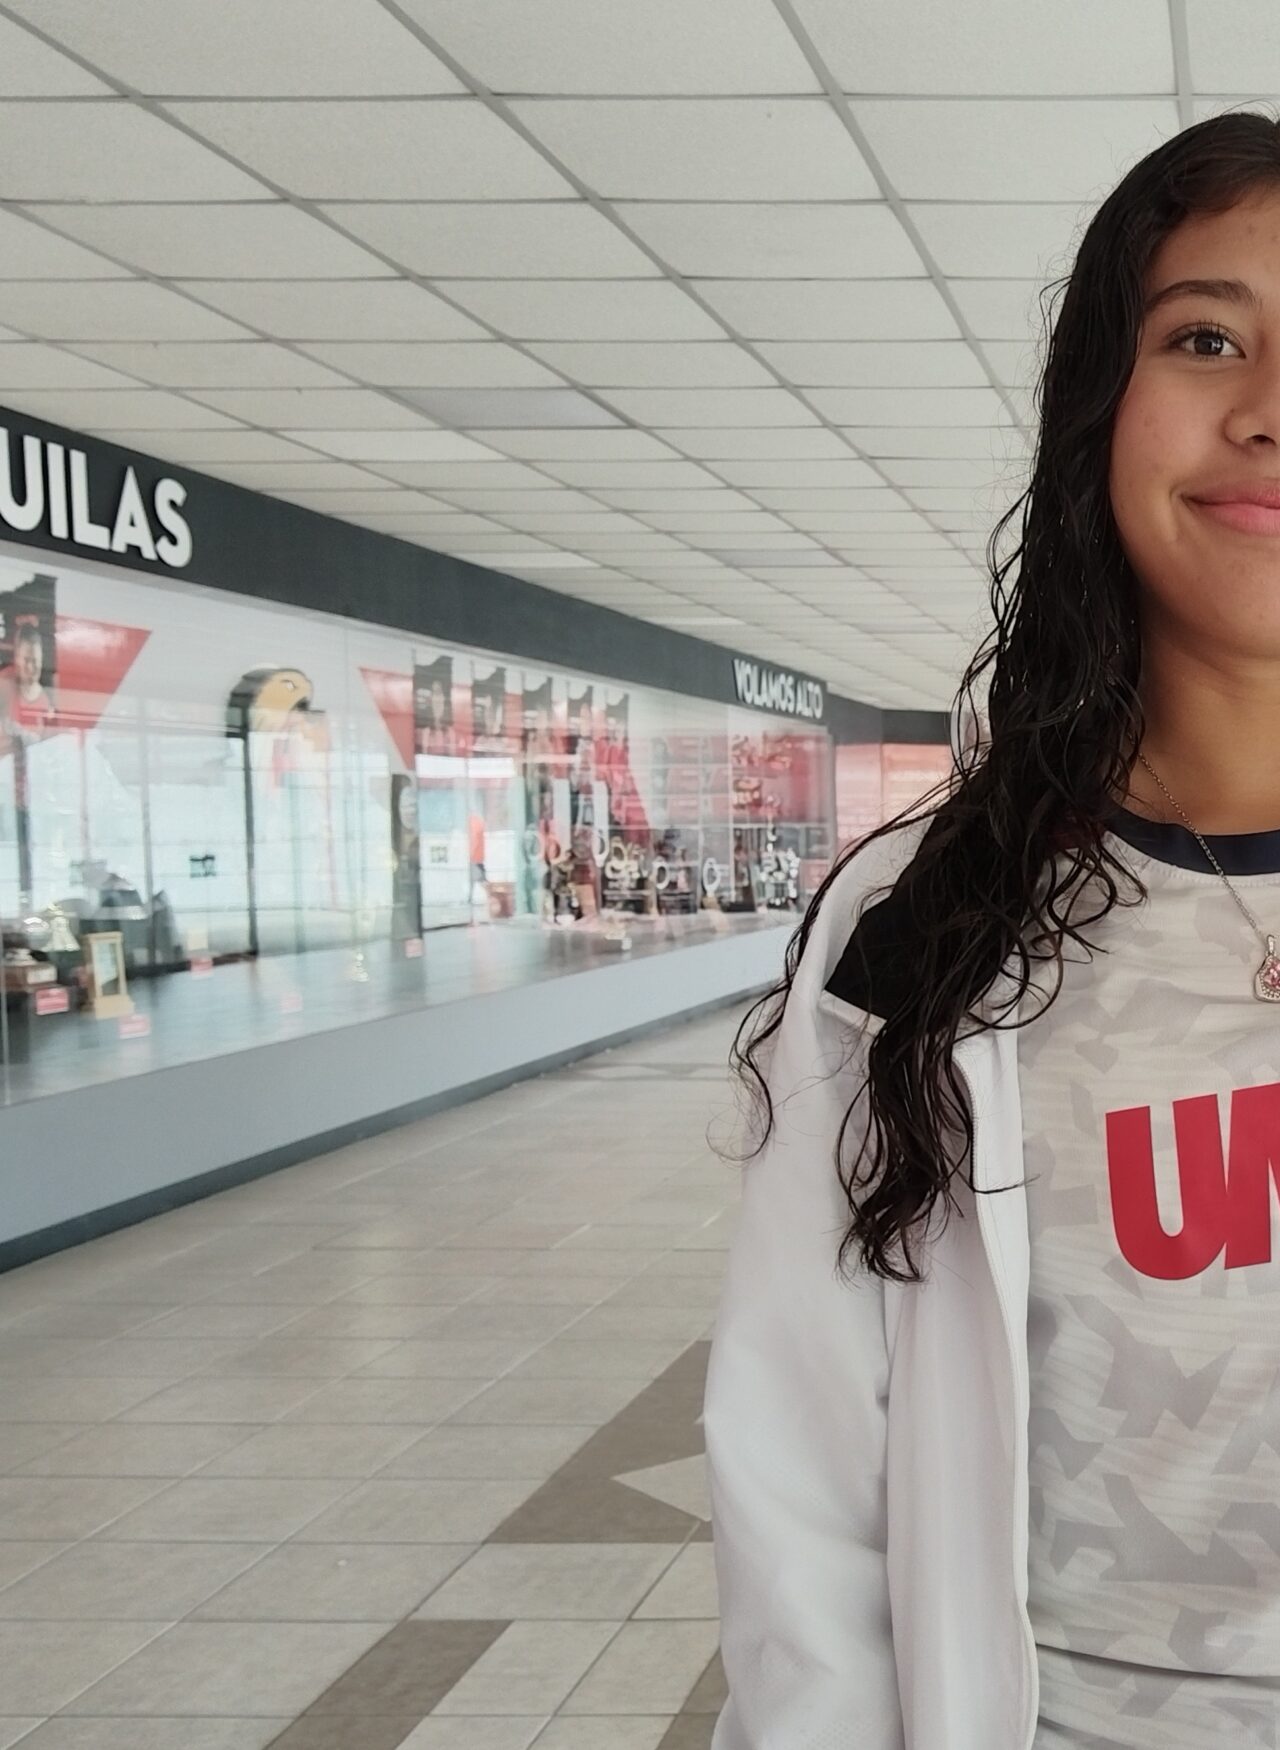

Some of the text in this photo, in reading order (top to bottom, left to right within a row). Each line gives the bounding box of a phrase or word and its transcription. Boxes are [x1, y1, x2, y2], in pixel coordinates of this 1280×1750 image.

[0, 427, 193, 568] UILAS
[733, 658, 824, 719] VOLAMOS ALTO
